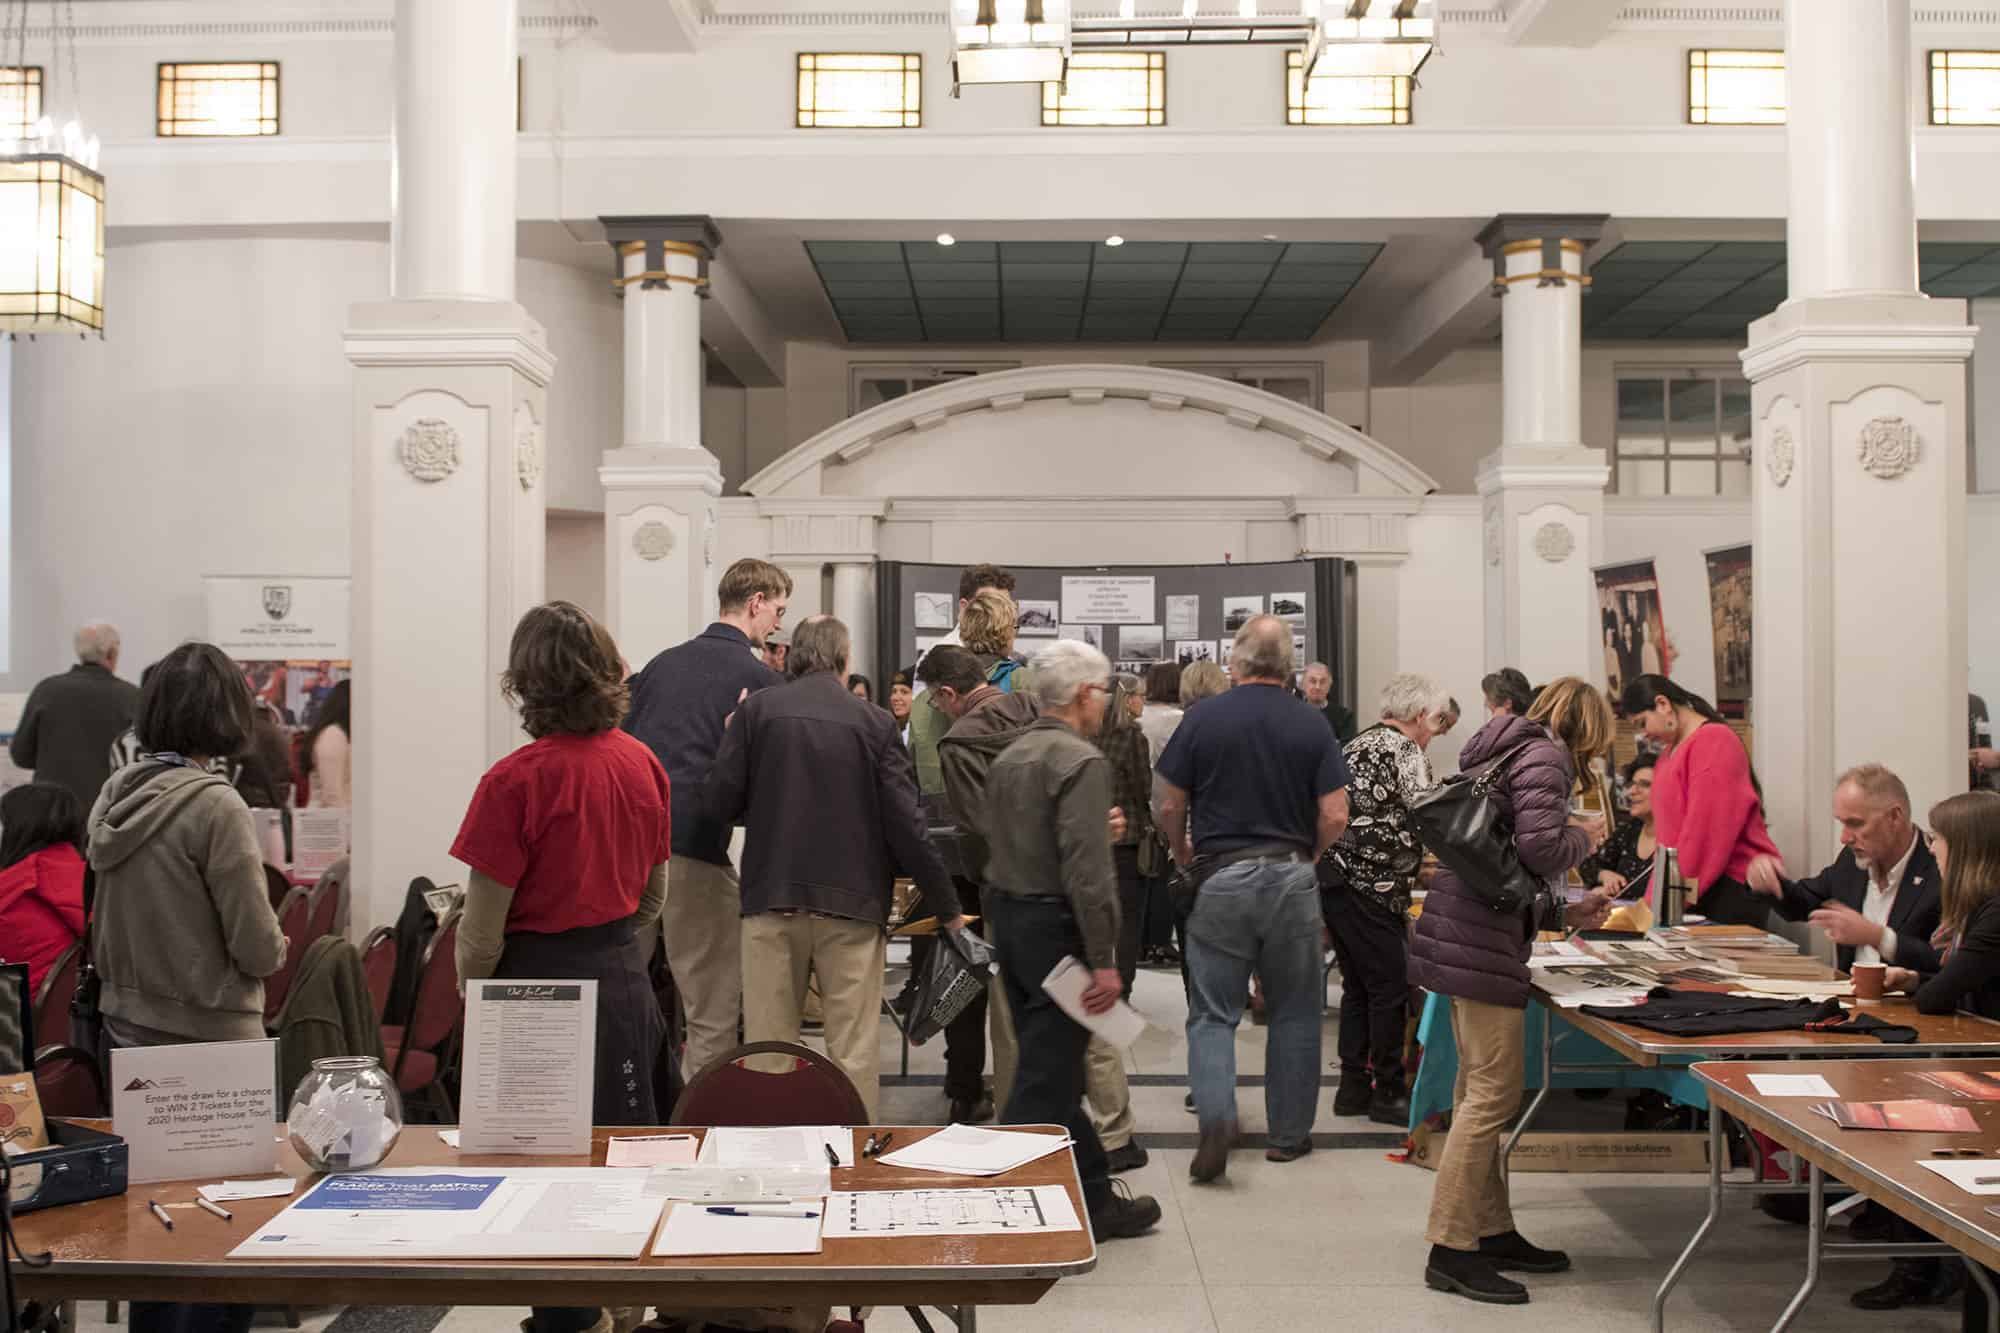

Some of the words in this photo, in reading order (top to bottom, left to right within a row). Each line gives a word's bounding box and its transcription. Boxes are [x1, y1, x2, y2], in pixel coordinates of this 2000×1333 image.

[145, 1094, 170, 1104] Enter
[173, 1092, 188, 1101] the
[190, 1091, 214, 1100] draw
[216, 1088, 231, 1098] for
[232, 1090, 238, 1098] a
[240, 1087, 272, 1097] chance
[154, 1105, 164, 1114] to
[166, 1102, 188, 1113] WIN
[190, 1102, 197, 1111] 2
[198, 1100, 232, 1110] Tickets
[233, 1099, 247, 1108] for
[249, 1098, 264, 1107] the
[147, 1115, 171, 1125] 2020
[174, 1112, 214, 1123] Heritage
[216, 1110, 245, 1120] House
